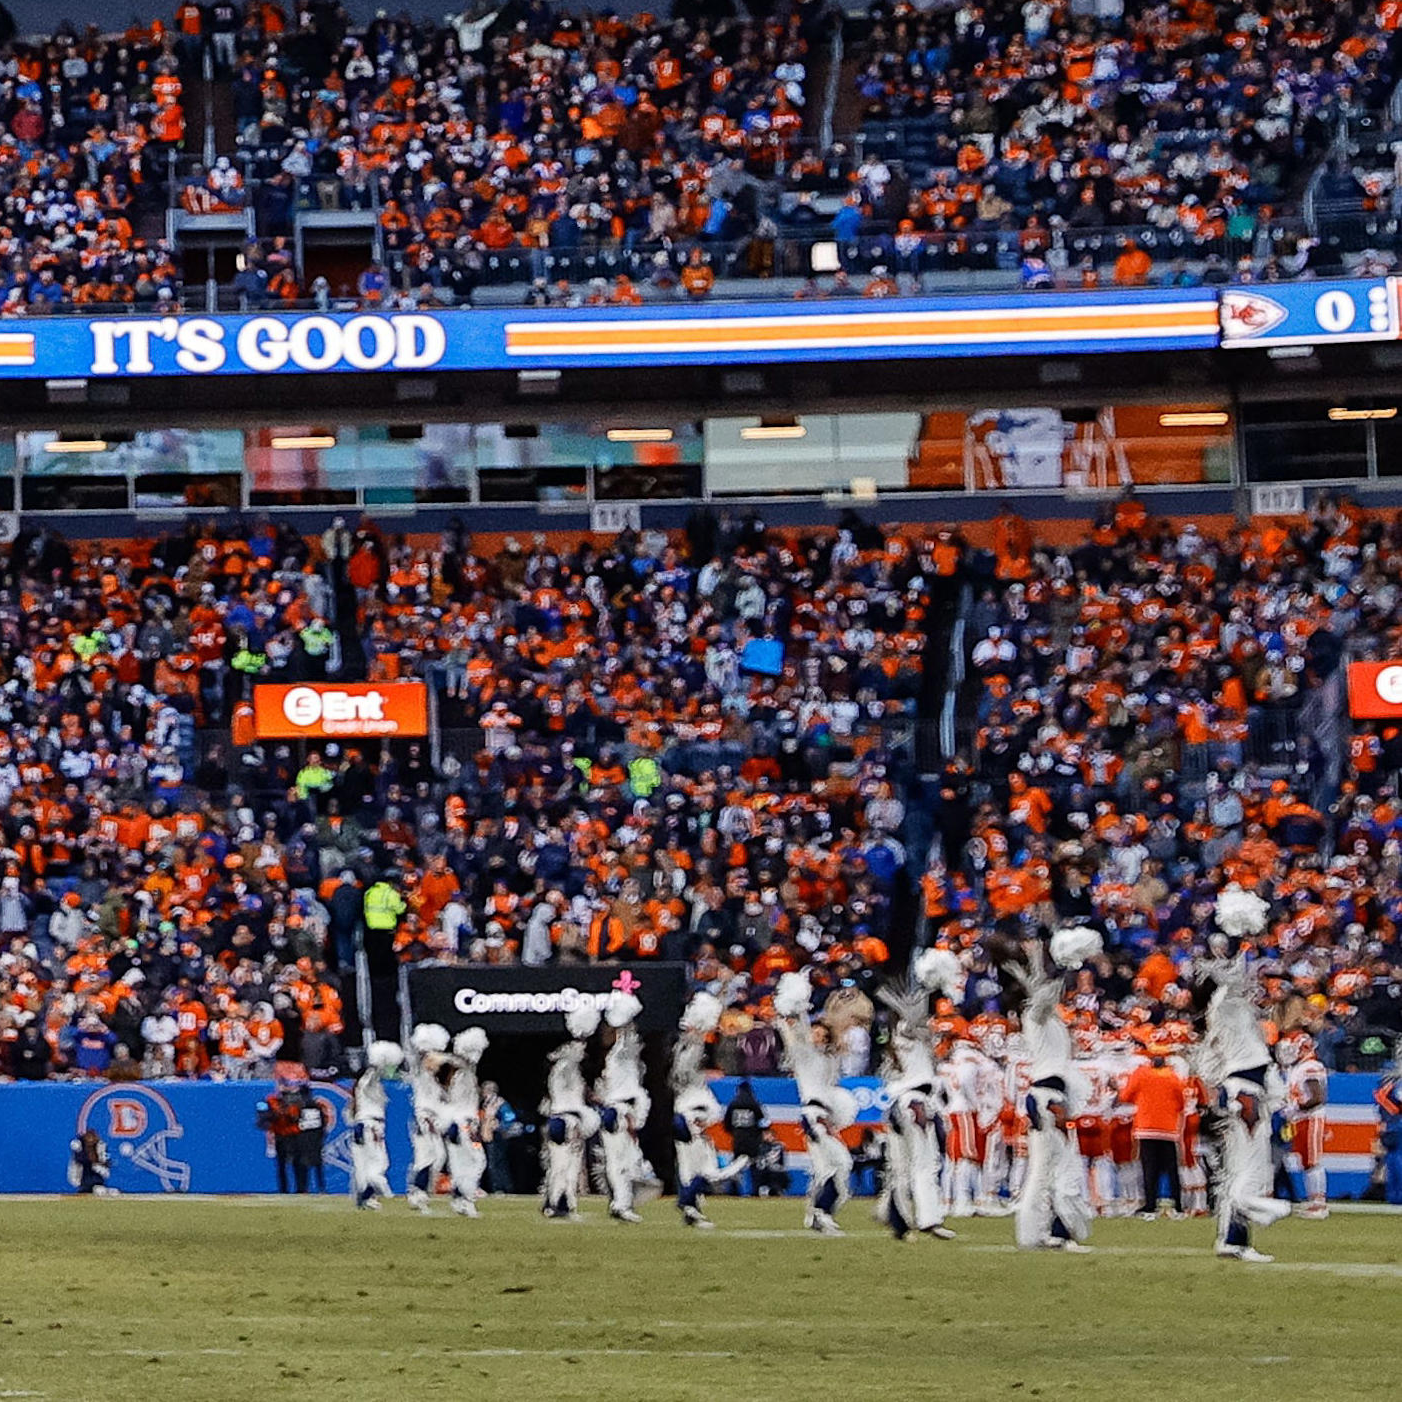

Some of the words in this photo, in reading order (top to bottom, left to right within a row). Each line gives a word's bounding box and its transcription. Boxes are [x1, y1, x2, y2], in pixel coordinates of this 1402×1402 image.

[1314, 290, 1356, 332] 0
[90, 317, 227, 375] IT'S
[237, 315, 446, 373] GOOD
[322, 691, 384, 720] Ent
